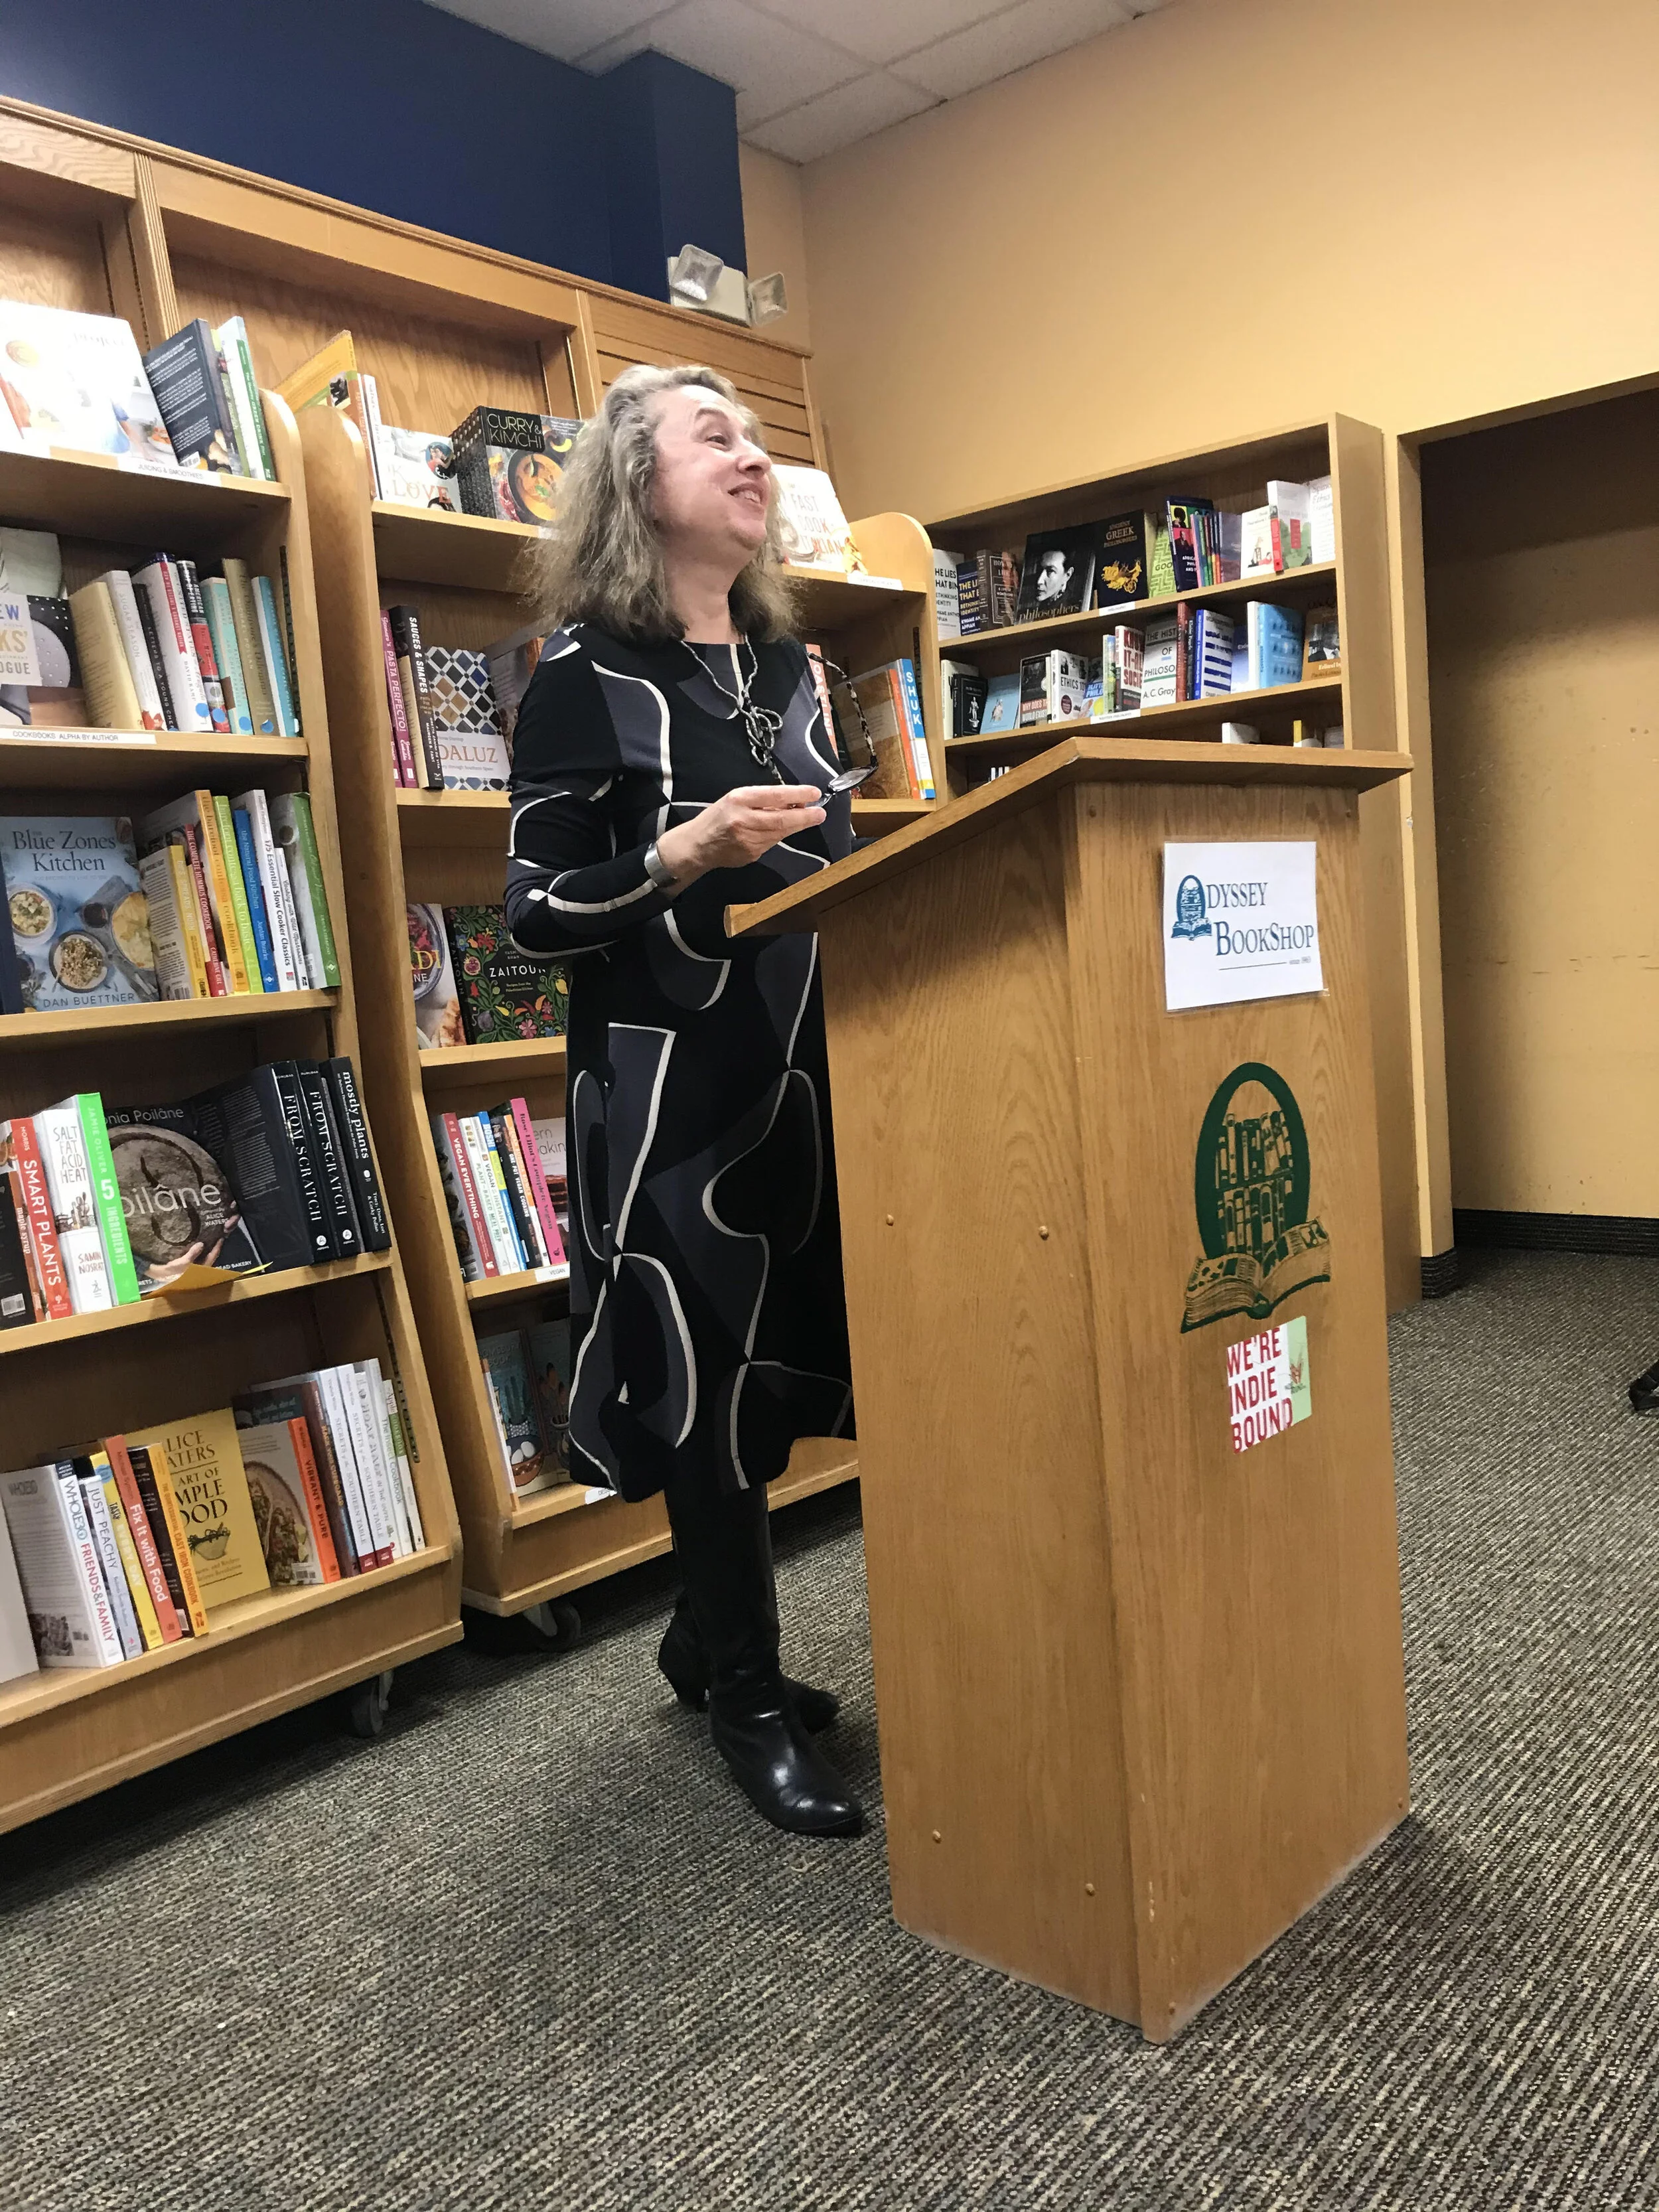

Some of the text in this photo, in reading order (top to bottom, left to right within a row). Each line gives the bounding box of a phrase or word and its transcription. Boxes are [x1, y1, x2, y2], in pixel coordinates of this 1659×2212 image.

[487, 413, 534, 432] CURRY
[535, 425, 541, 435] &
[490, 429, 541, 449] KIMCHI
[1106, 526, 1134, 540] GREEK
[935, 568, 944, 577] HE
[936, 579, 958, 590] HAT BIN
[125, 627, 141, 656] SEASON
[1147, 632, 1158, 640] THE
[385, 650, 397, 677] PASTA
[407, 617, 421, 649] SAUCES
[415, 662, 428, 692] SHAPES
[1162, 647, 1173, 656] OF
[159, 682, 170, 706] YOUNG
[1061, 676, 1078, 690] ETHICS
[905, 672, 922, 725] SHUK
[13, 830, 117, 851] Blue Zones
[33, 851, 106, 873] Kitchen
[267, 853, 280, 889] Essential
[273, 889, 281, 910] Slow
[238, 911, 247, 920] to
[276, 910, 286, 936] Cooker
[281, 937, 292, 966] Classics
[43, 992, 135, 1008] DAN BUETTNER
[133, 1108, 184, 1122] Poilâne
[343, 1071, 370, 1159] mostly plants
[53, 1126, 77, 1142] SALT
[60, 1140, 77, 1154] FAT
[88, 1107, 108, 1173] JAMIE OLIVER
[61, 1154, 82, 1169] ACID
[284, 1095, 322, 1221] FROM SCRATCH
[309, 1091, 348, 1215] FROM SCRATCH
[60, 1167, 86, 1183] HEAT
[452, 1138, 480, 1218] VEGAN EVERYTHING
[483, 1164, 496, 1187] VEGAN
[514, 1177, 524, 1194] VEGAN
[519, 1195, 530, 1217] COOKING
[17, 1207, 31, 1254] maple syrup
[24, 1160, 61, 1286] SMART PLANTS
[101, 1179, 128, 1265] 5 INGREDIENTS
[78, 1252, 102, 1264] SAMIN
[1227, 1327, 1281, 1378] WE'RE
[1230, 1366, 1277, 1416] INDIE
[1231, 1398, 1293, 1454] BOUND
[167, 1430, 205, 1453] LICE
[178, 1476, 200, 1487] ART
[334, 1417, 347, 1453] SECRETS
[346, 1471, 361, 1516] SOUTHERN
[355, 1518, 367, 1545] TABLE
[351, 1412, 365, 1447] SECRETS
[363, 1466, 378, 1511] SOUTHERN
[372, 1511, 385, 1539] TABLE
[390, 1461, 404, 1505] Cookbook
[175, 1479, 226, 1506] MPLE
[304, 1459, 320, 1501] VIBRANT
[317, 1512, 329, 1539] PURE
[129, 1503, 145, 1524] Fix
[180, 1499, 228, 1526] OOD
[88, 1488, 118, 1569] JUST PEACHY
[135, 1526, 149, 1536] It
[139, 1538, 158, 1567] with
[173, 1532, 184, 1552] CAST
[178, 1551, 188, 1568] IRON
[148, 1568, 169, 1601] Food
[182, 1568, 198, 1605] COOKBOOK
